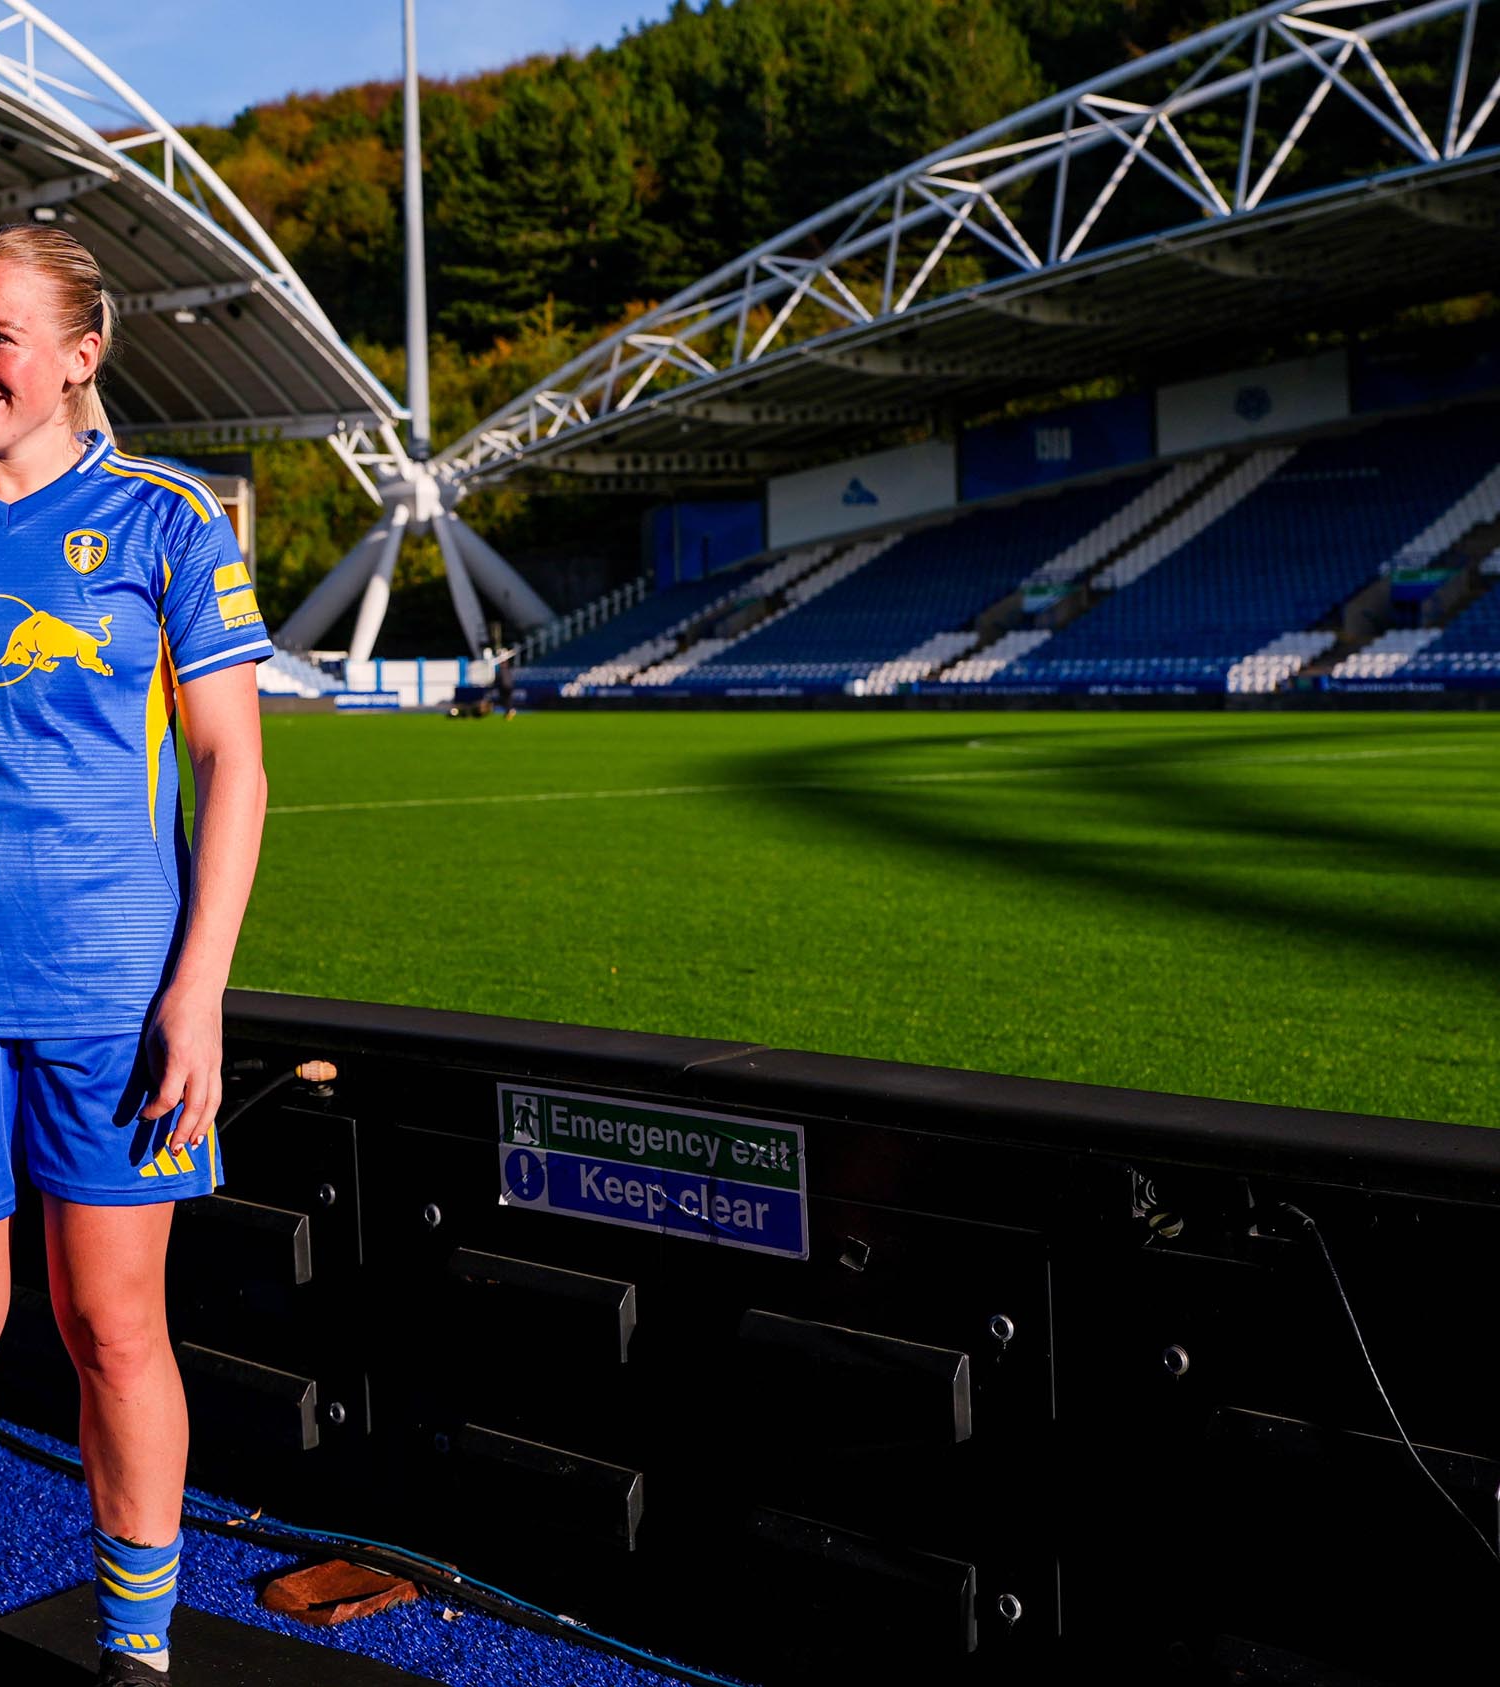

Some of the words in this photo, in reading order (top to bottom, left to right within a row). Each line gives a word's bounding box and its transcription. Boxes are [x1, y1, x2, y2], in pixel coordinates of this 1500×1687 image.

[552, 1106, 720, 1167] Emergency
[731, 1137, 790, 1172] exit
[579, 1163, 667, 1219] Keep
[679, 1183, 770, 1231] clear
